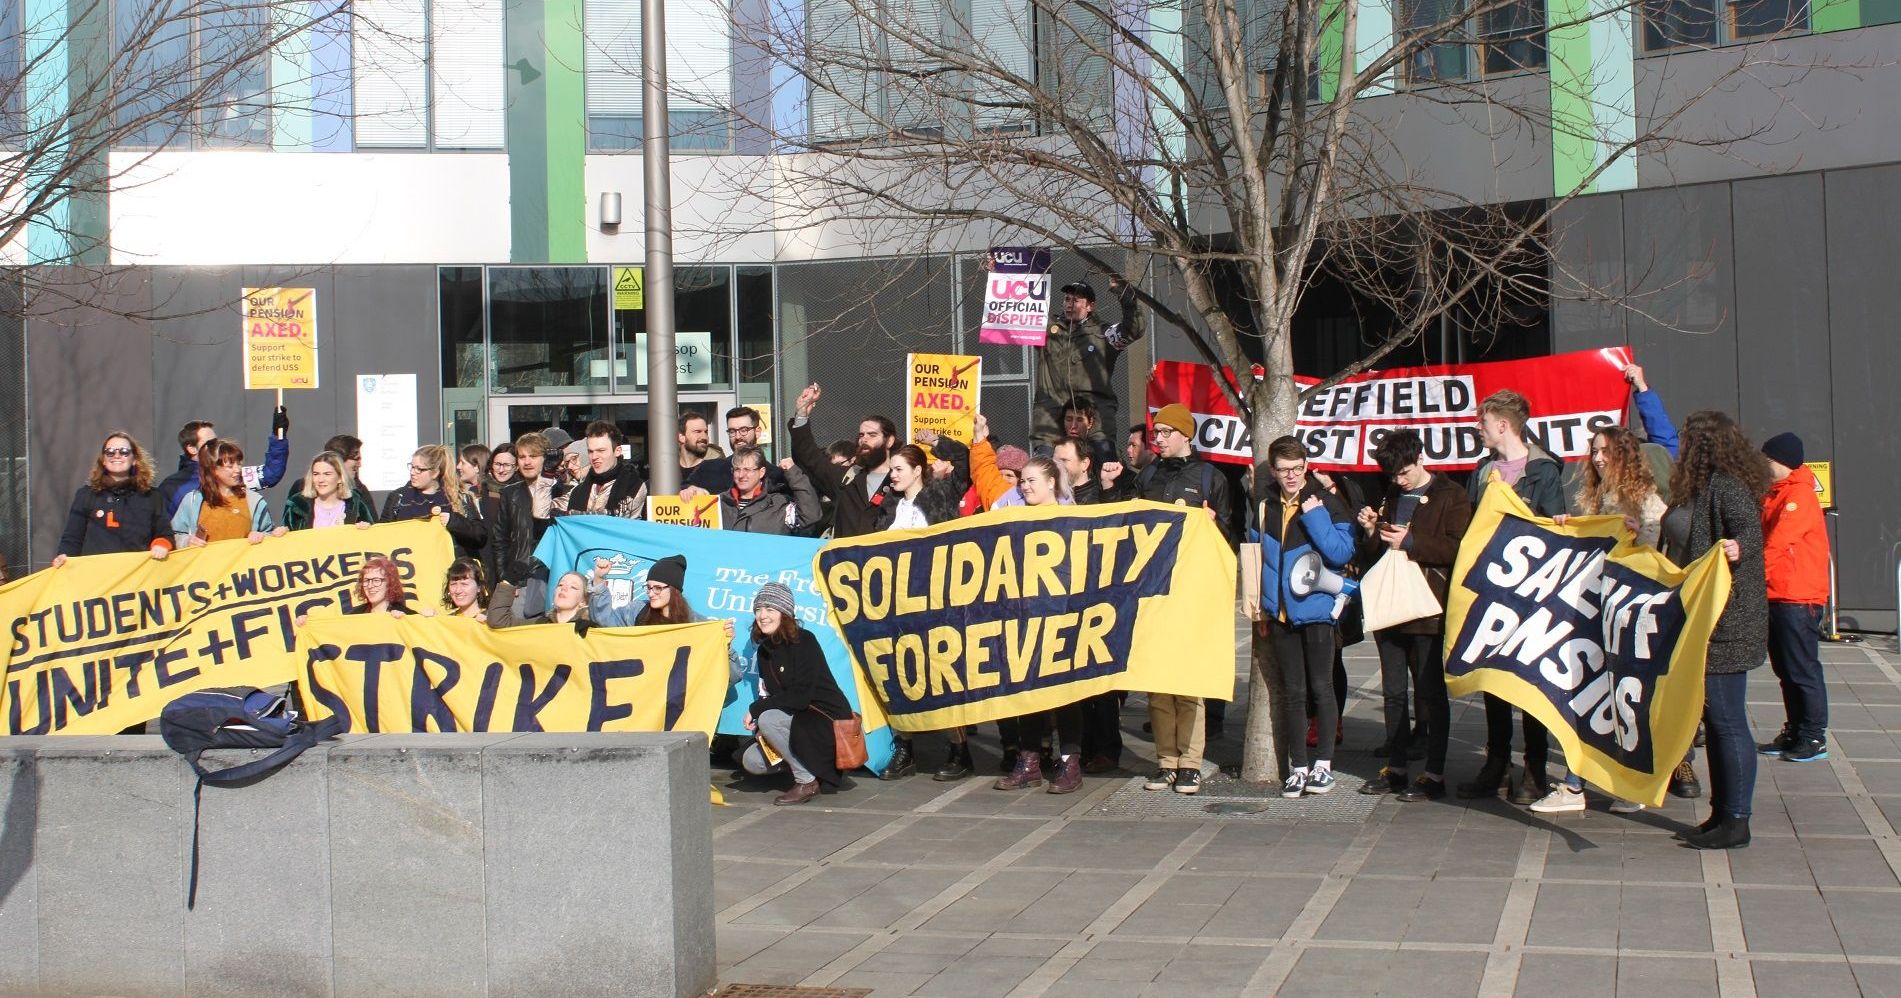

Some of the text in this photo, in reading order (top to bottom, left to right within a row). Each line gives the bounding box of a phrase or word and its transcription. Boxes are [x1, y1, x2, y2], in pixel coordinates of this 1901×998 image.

[250, 297, 274, 306] OUR
[988, 301, 1045, 313] OFFICIAL
[250, 308, 304, 318] PENSION
[987, 312, 1044, 326] DISPUTE
[252, 322, 307, 337] AXED.
[251, 344, 286, 352] Support
[674, 345, 698, 357] sop
[251, 364, 281, 372] defend
[915, 364, 940, 374] OUR
[914, 376, 969, 390] PENSION
[913, 393, 970, 411] AXED.
[1302, 379, 1470, 417] EFFIELD
[914, 415, 947, 425] Support
[931, 428, 952, 436] trike
[655, 506, 681, 516] OUR
[715, 567, 769, 585] The
[827, 521, 1173, 625] SOLIDARITY
[10, 547, 416, 657] STUDENTS+WORKES
[863, 602, 1118, 703] FOREVER
